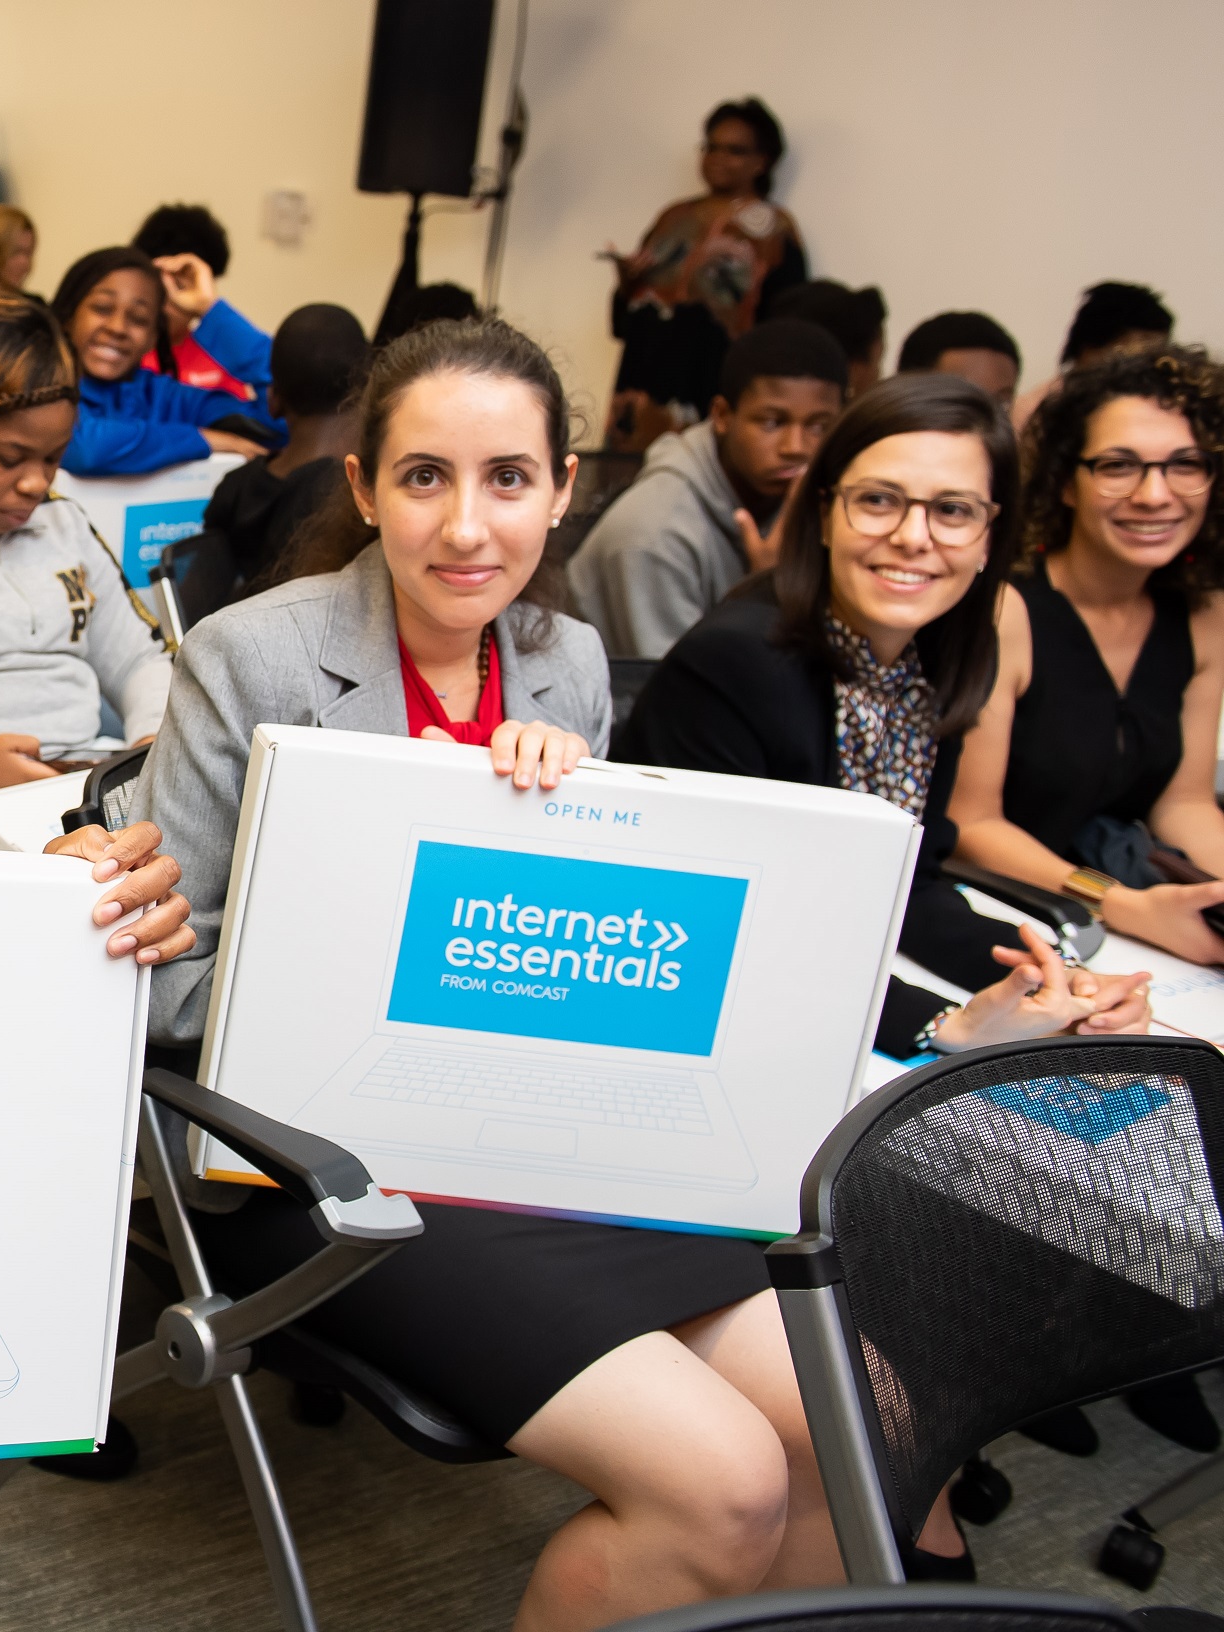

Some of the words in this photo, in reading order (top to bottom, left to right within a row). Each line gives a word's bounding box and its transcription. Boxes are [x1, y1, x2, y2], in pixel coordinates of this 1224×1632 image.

[544, 801, 602, 821] OPEN
[613, 810, 642, 827] ME
[452, 893, 648, 950] internet
[444, 937, 683, 992] essentials
[440, 973, 487, 992] FROM
[492, 980, 570, 1002] COMCAST
